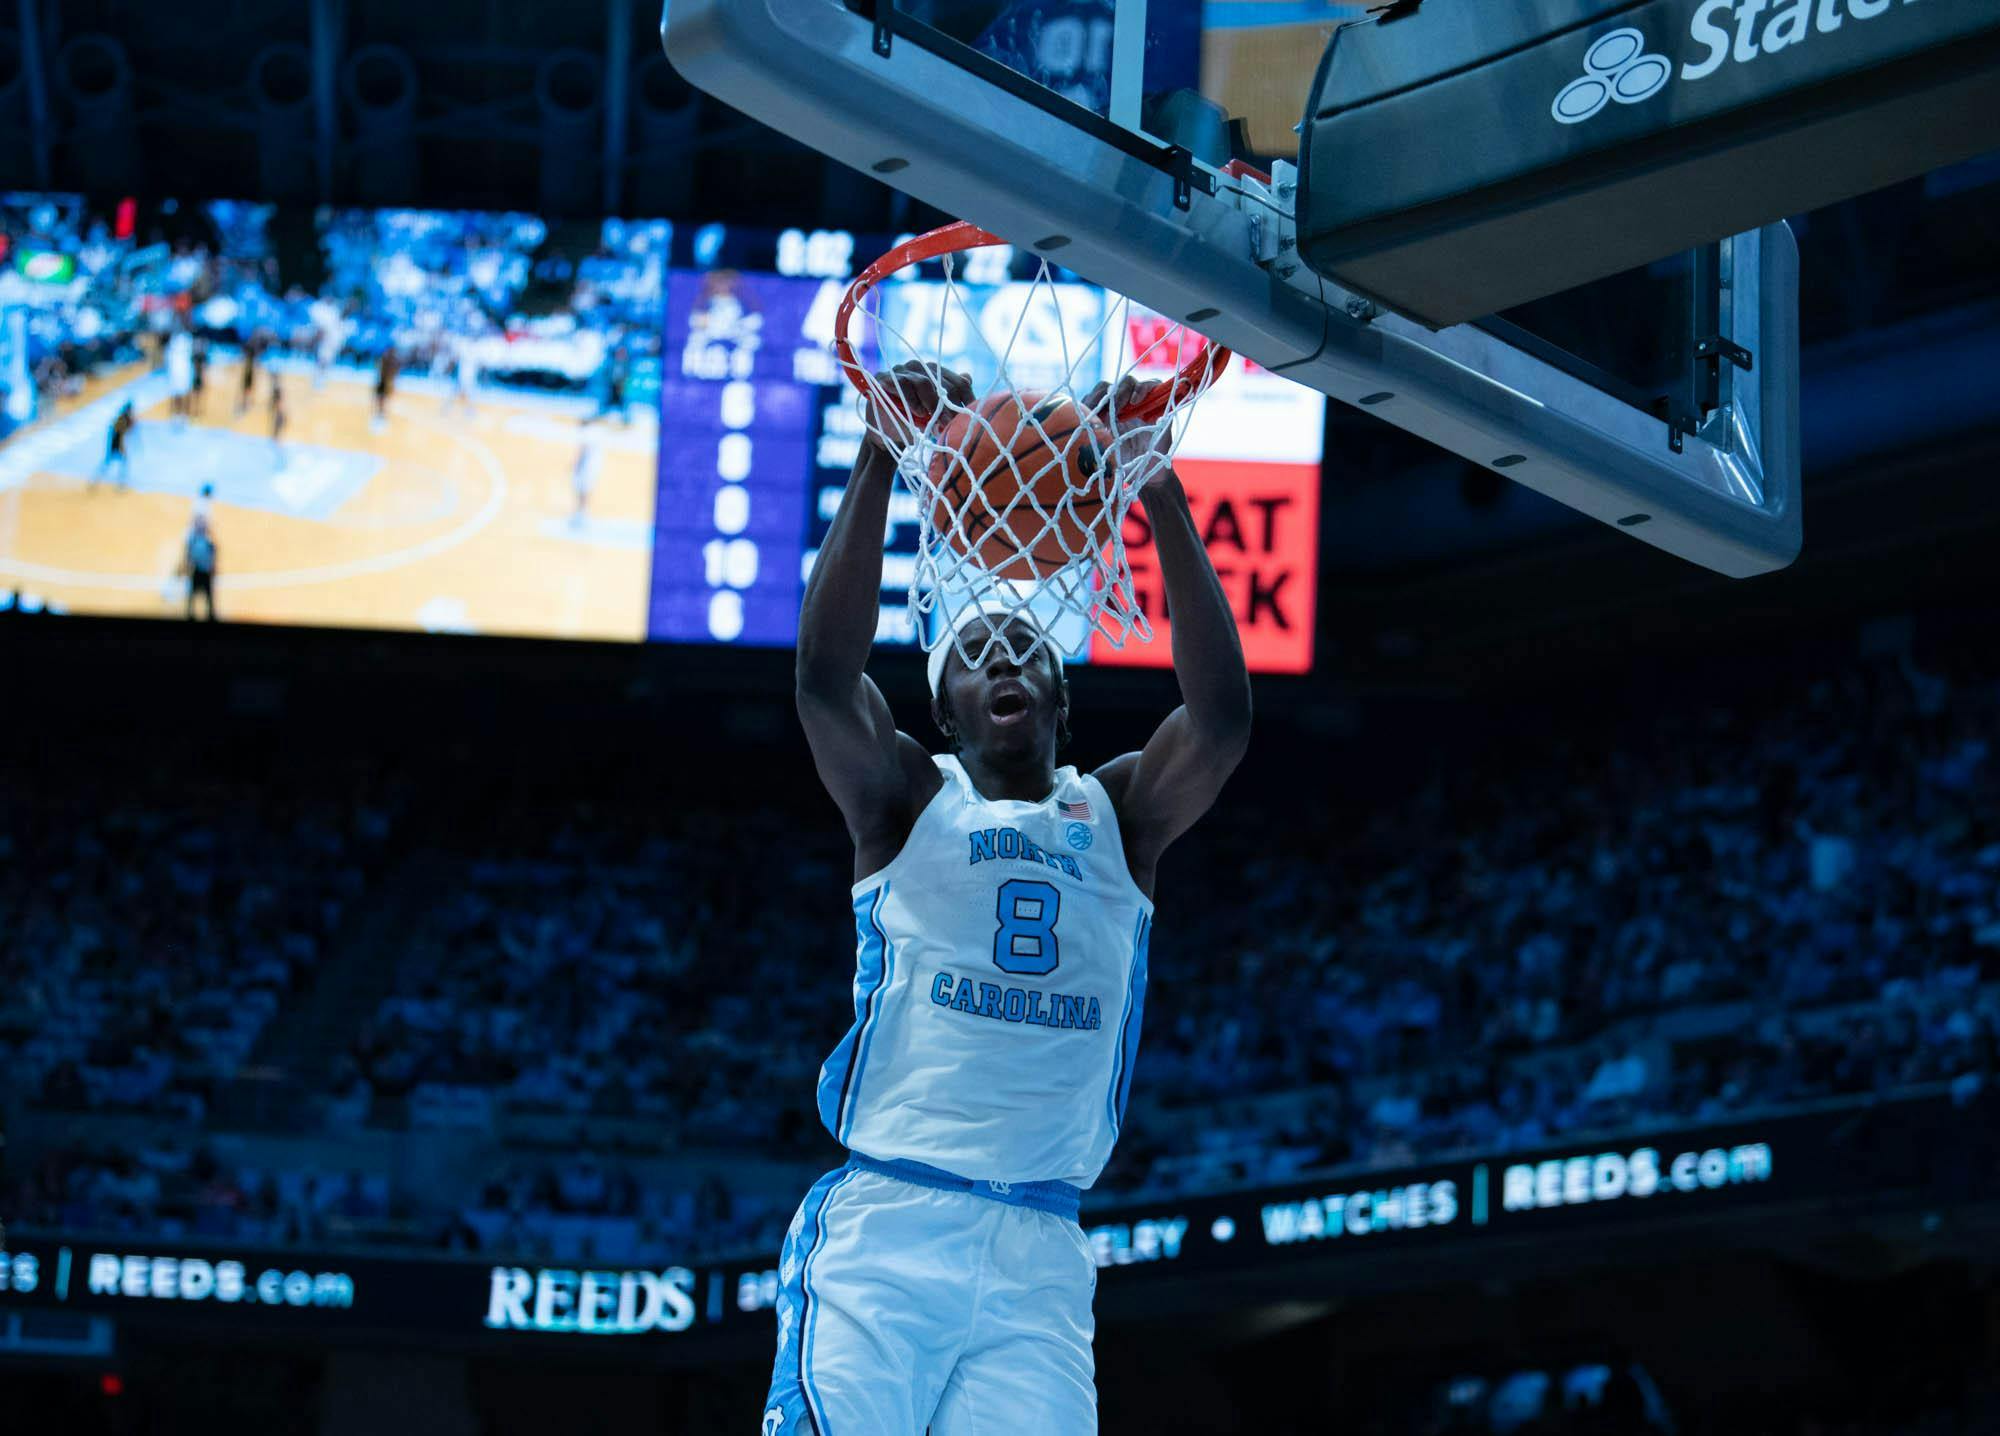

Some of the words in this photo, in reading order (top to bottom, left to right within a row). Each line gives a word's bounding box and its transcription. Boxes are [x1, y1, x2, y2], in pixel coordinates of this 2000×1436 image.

[993, 879, 1061, 976] 8
[931, 971, 1101, 1030] CAROLINA
[1261, 1179, 1457, 1245] WATCHES
[1503, 1142, 1772, 1212] REEDS.com
[89, 1252, 354, 1308] REEDS.com
[484, 1266, 696, 1334] REEDS
